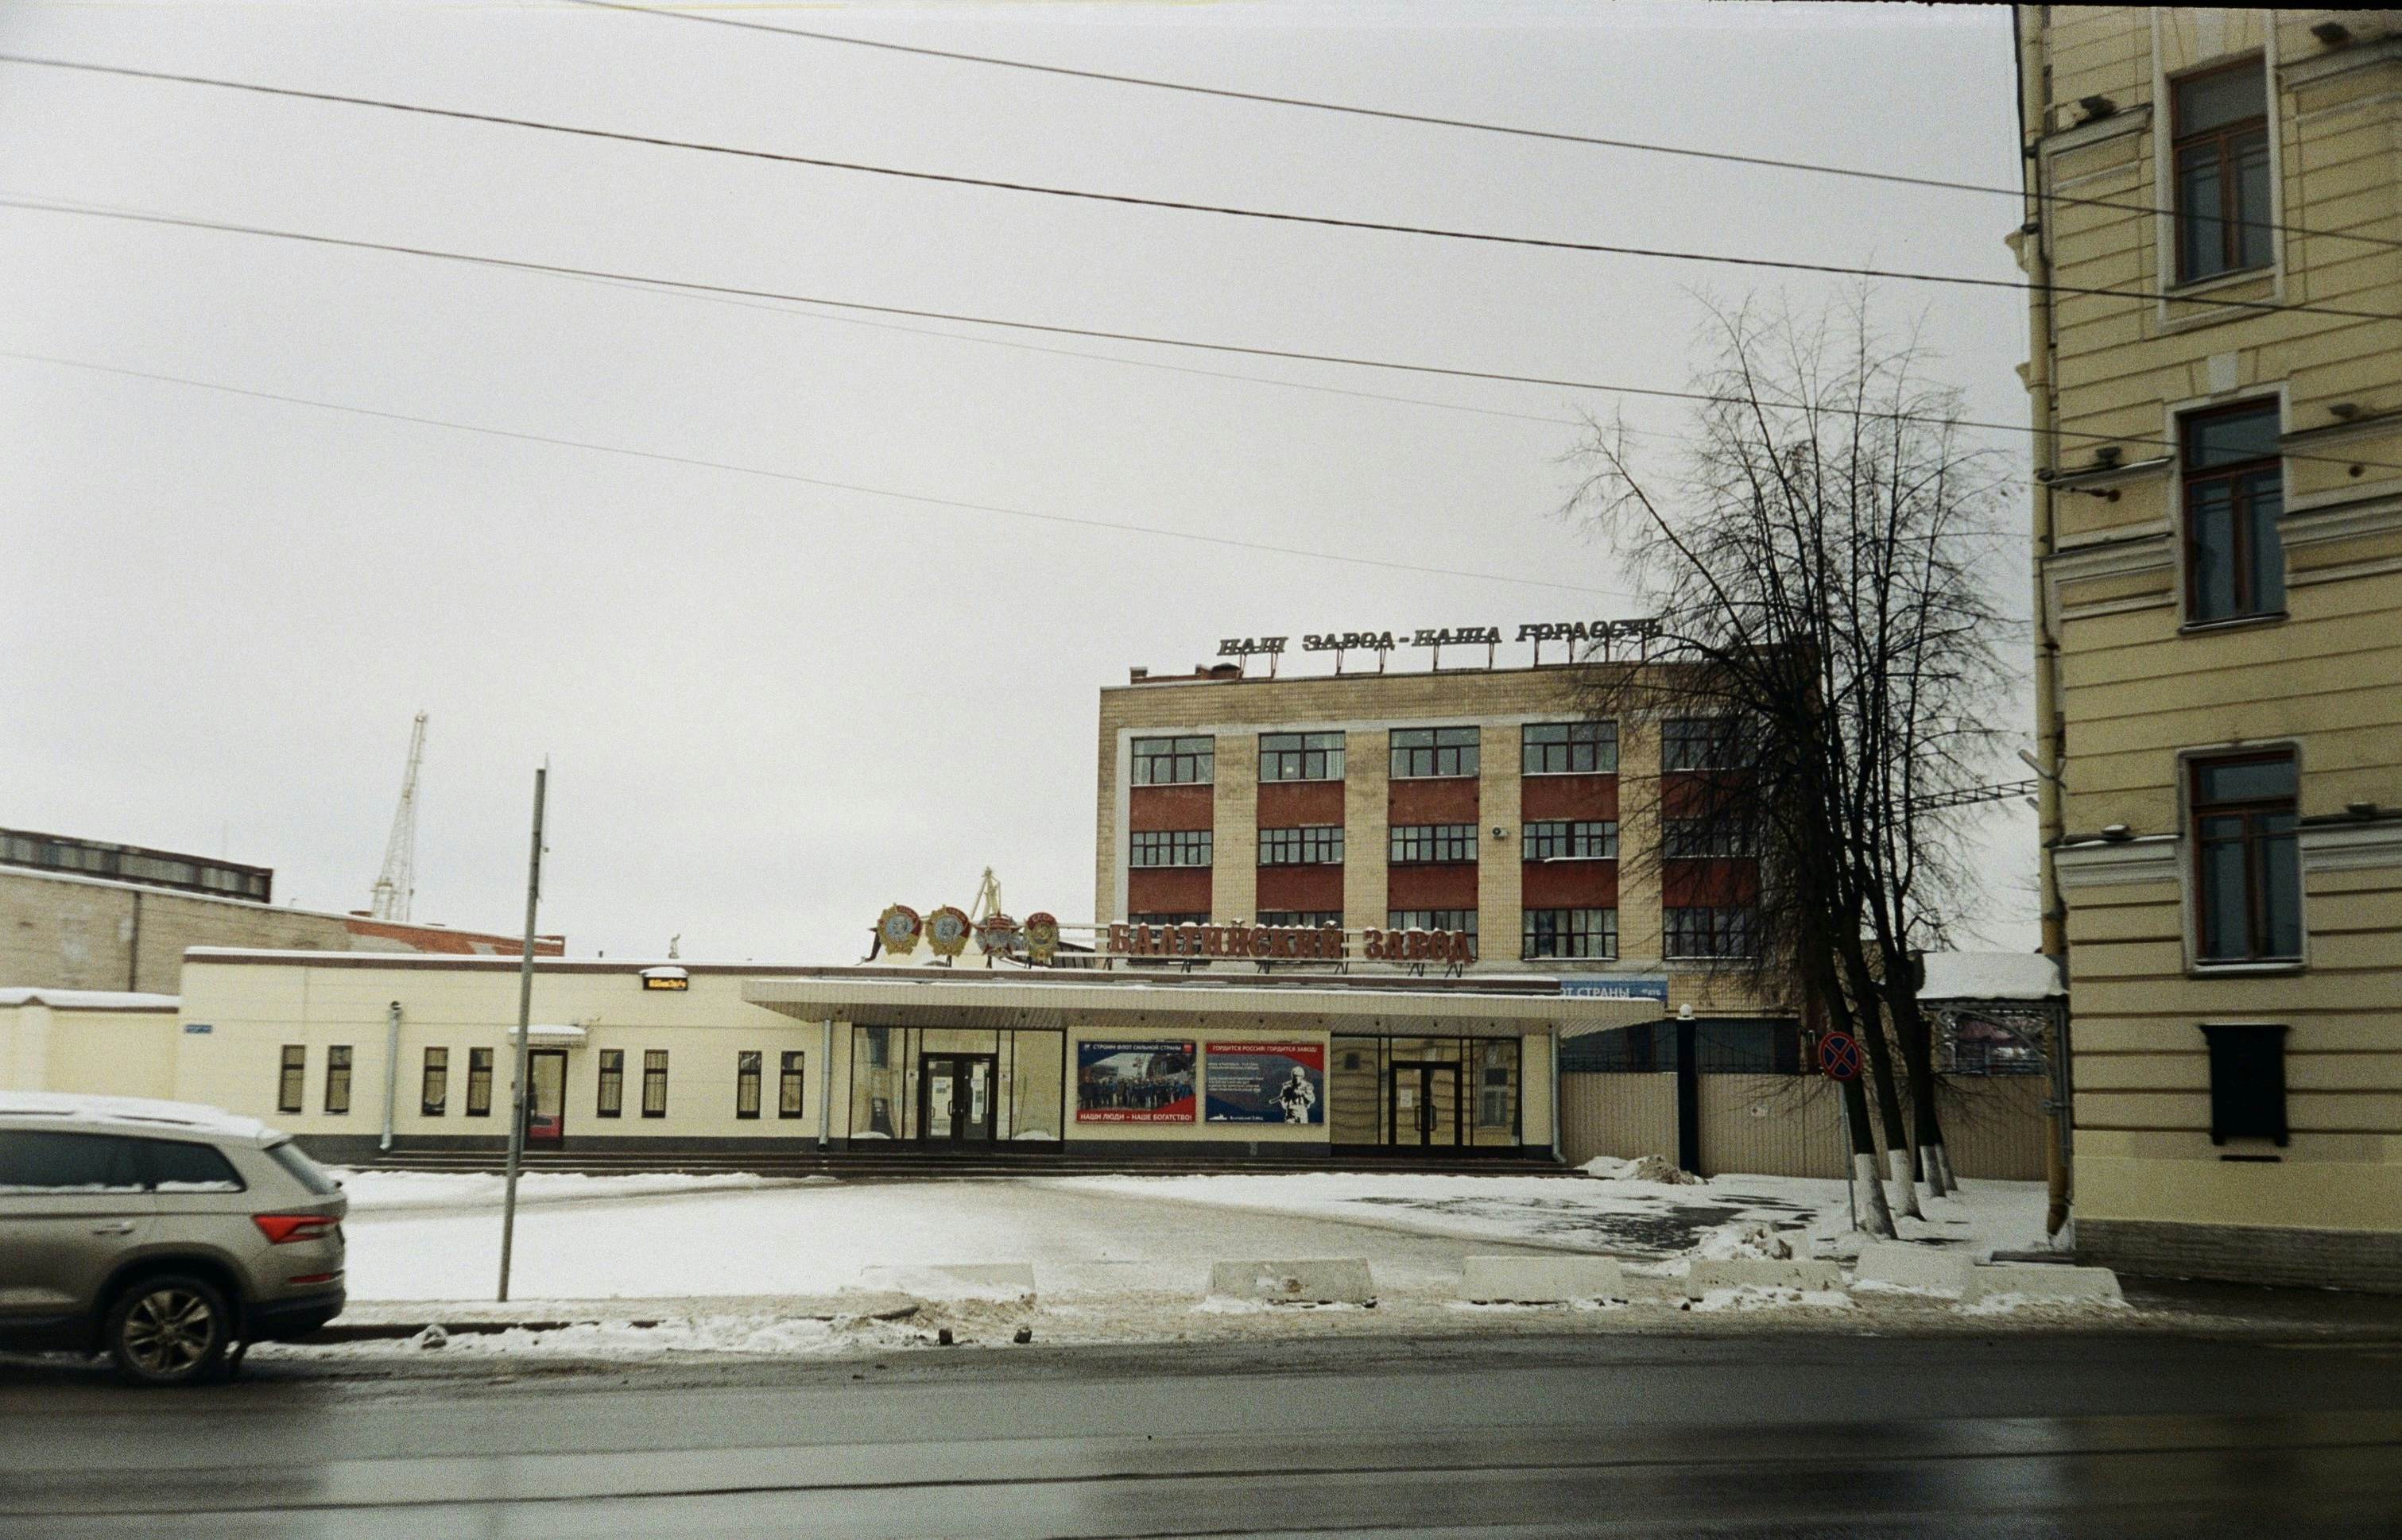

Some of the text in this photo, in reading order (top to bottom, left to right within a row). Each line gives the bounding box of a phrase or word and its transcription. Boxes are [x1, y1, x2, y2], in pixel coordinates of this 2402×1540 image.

[1217, 637, 1288, 656] НАШ
[1515, 618, 1664, 642] ГОРДОСТЬ
[1108, 920, 1473, 965] БАЛТИЙСКИЙ ЗАВОД
[1577, 988, 1629, 997] СТРАНЫ
